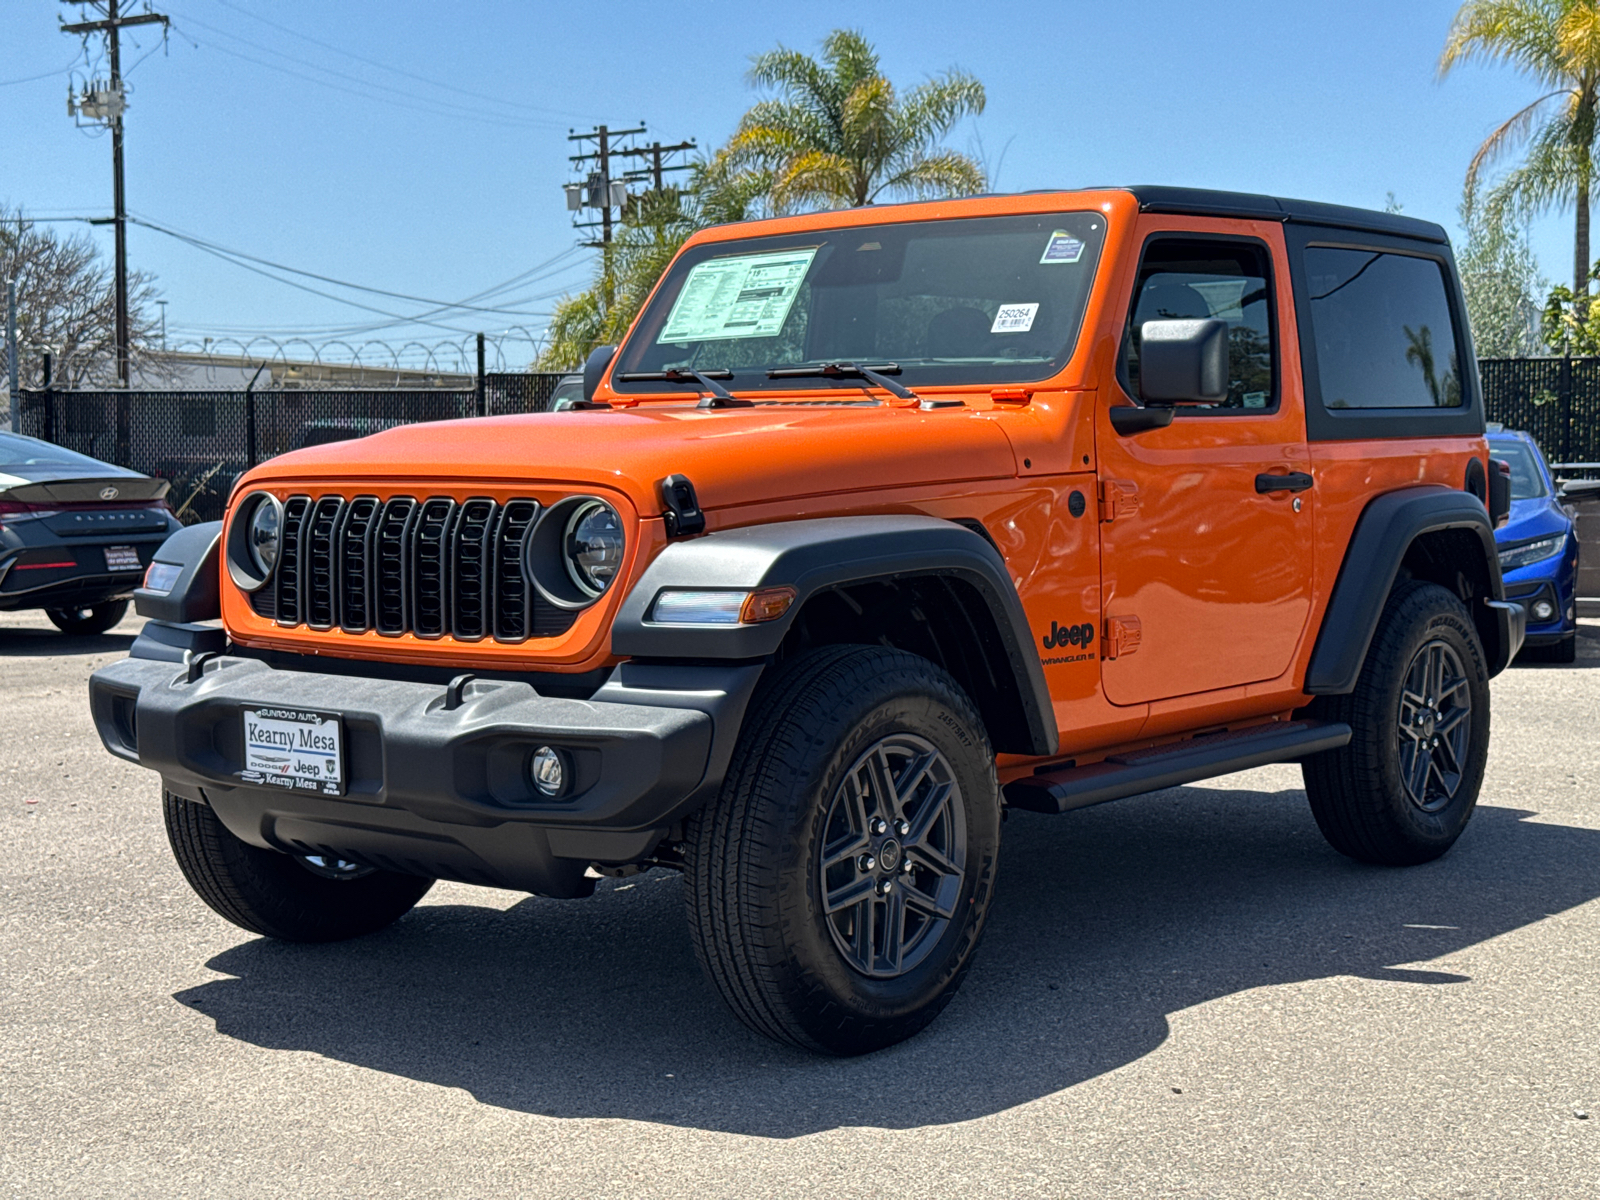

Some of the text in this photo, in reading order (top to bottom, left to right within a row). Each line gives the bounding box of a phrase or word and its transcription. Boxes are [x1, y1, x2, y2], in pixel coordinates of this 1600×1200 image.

[999, 308, 1031, 319] 250264
[75, 513, 145, 521] ELANTRA
[1043, 621, 1095, 650] Jeep
[1430, 616, 1469, 640] ROADIAN
[1041, 653, 1087, 666] WRANGLER
[261, 708, 318, 722] SUNROAD AUTO
[248, 722, 336, 753] Kearny Mesa
[937, 711, 973, 748] 245/75R17
[294, 759, 320, 777] Jeep
[266, 773, 295, 789] Kearny
[296, 777, 317, 790] Mesa
